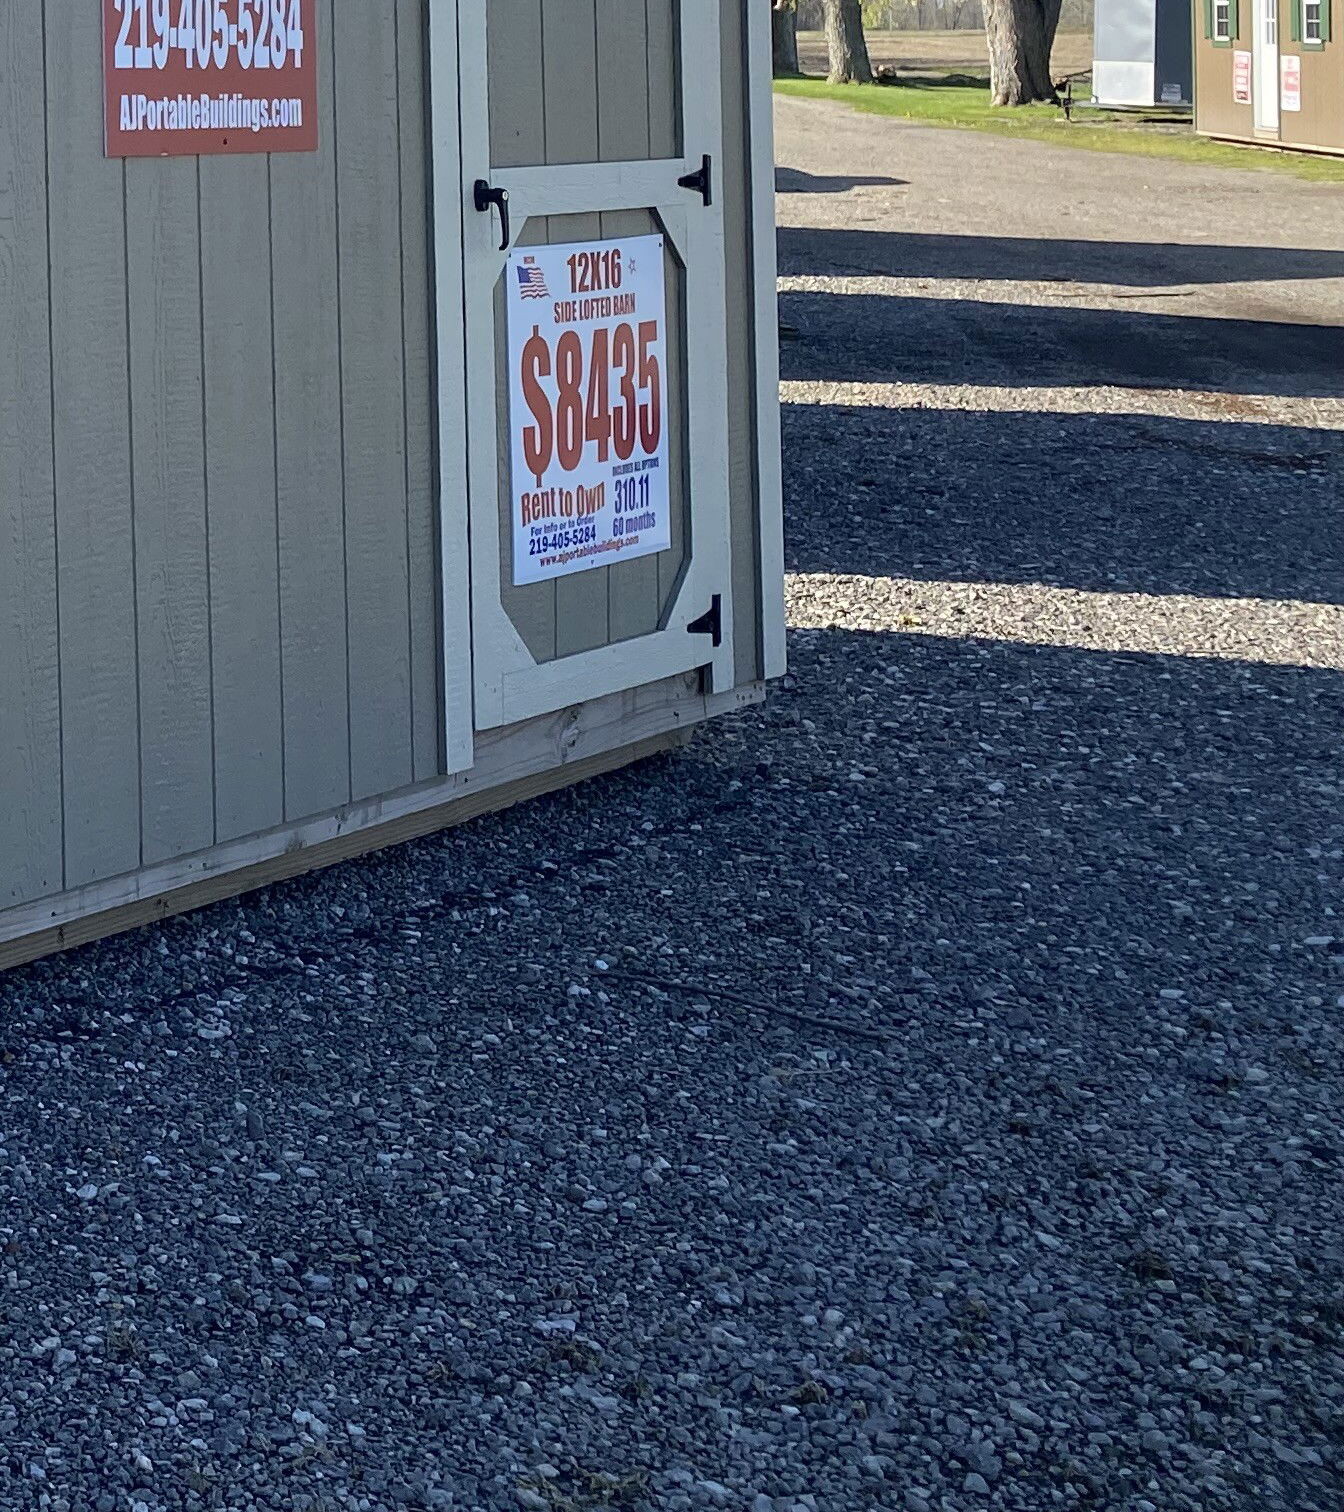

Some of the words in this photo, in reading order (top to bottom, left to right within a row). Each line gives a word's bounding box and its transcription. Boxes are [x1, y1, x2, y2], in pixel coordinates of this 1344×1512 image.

[119, 93, 303, 132] AJPortableBuildings.com
[567, 248, 622, 294] 12X16
[554, 300, 577, 324] SIDE
[579, 296, 611, 321] LOFTED
[613, 292, 636, 317] BARN
[521, 320, 660, 488] $8435
[521, 487, 557, 528] Rent
[559, 487, 573, 517] to
[576, 481, 605, 518] Own
[614, 473, 649, 514] 310.11
[529, 525, 597, 556] 219-405-5284
[530, 526, 543, 537] For
[543, 522, 558, 534] Info
[559, 522, 567, 531] or
[576, 515, 595, 528] Order
[612, 516, 624, 537] 60
[625, 510, 656, 534] months
[540, 535, 640, 568] www.ajportablebuildings.com
